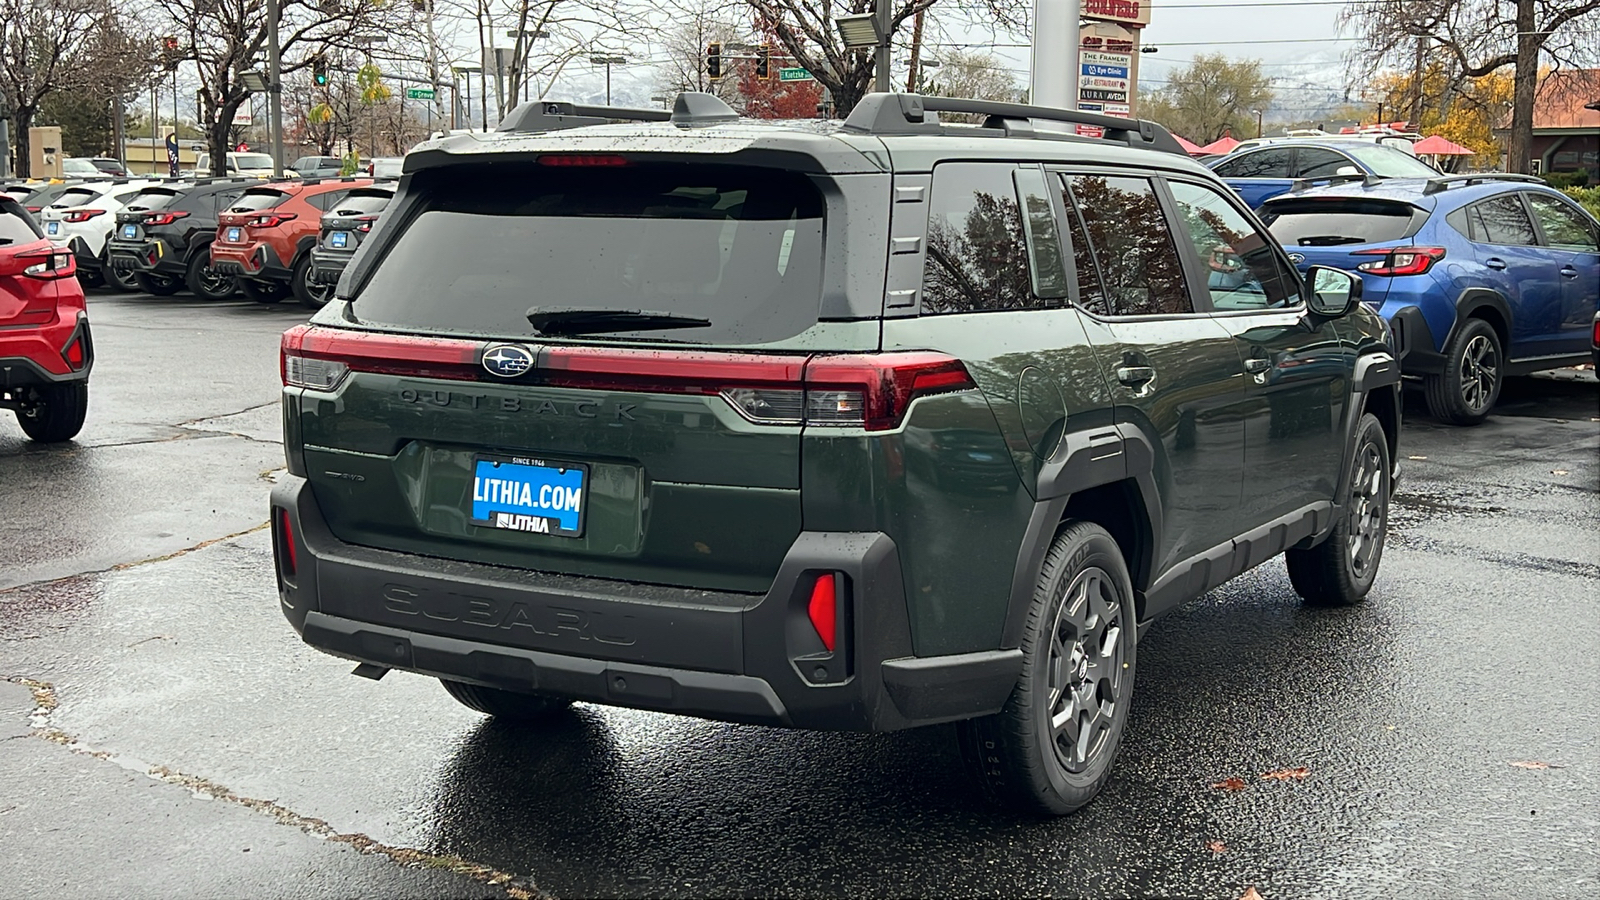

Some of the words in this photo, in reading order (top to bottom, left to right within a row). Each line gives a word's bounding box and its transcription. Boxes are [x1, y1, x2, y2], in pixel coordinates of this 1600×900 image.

[1083, 52, 1097, 60] THE
[1099, 53, 1128, 62] FRAMERY
[1097, 66, 1107, 75] Eye
[1107, 67, 1122, 75] Clinic
[1093, 78, 1120, 88] RESTAURANT
[1081, 90, 1104, 99] AURA
[1106, 92, 1126, 101] AVEDA
[400, 387, 637, 421] OUTBACK
[512, 457, 530, 466] SINCE
[531, 459, 545, 467] 1946
[473, 476, 582, 513] LITHIA.COM
[508, 513, 549, 533] LITHIA
[1052, 543, 1090, 610] DUNLOP
[382, 582, 638, 646] SUBARU
